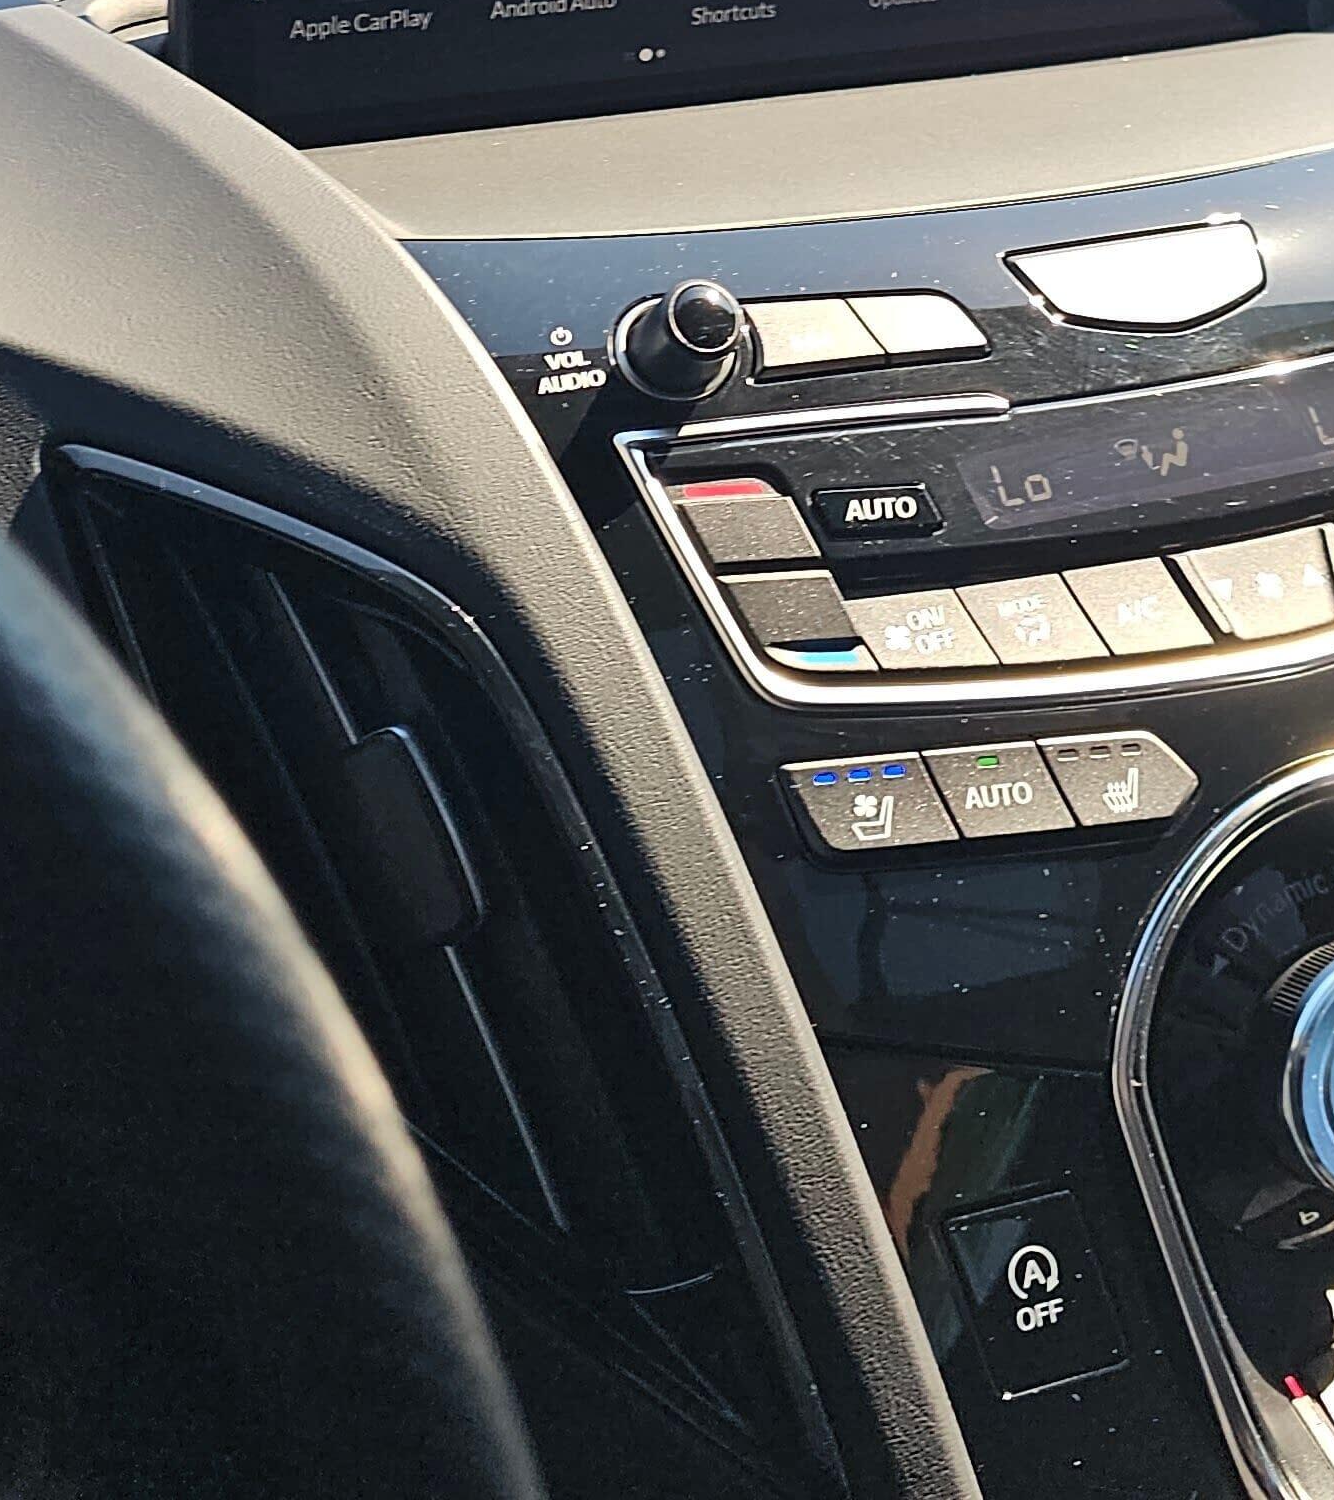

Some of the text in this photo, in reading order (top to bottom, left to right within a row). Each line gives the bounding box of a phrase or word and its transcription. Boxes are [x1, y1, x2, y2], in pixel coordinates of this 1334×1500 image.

[289, 9, 434, 42] Apple CarPlay
[690, 1, 777, 26] Shortcuts
[543, 350, 592, 371] VOL
[537, 368, 607, 395] AUDIO
[990, 465, 1053, 506] Lo
[844, 495, 918, 522] AUTO
[915, 627, 957, 655] OFF
[965, 781, 1033, 810] AUTO
[1016, 1297, 1064, 1332] OFF
